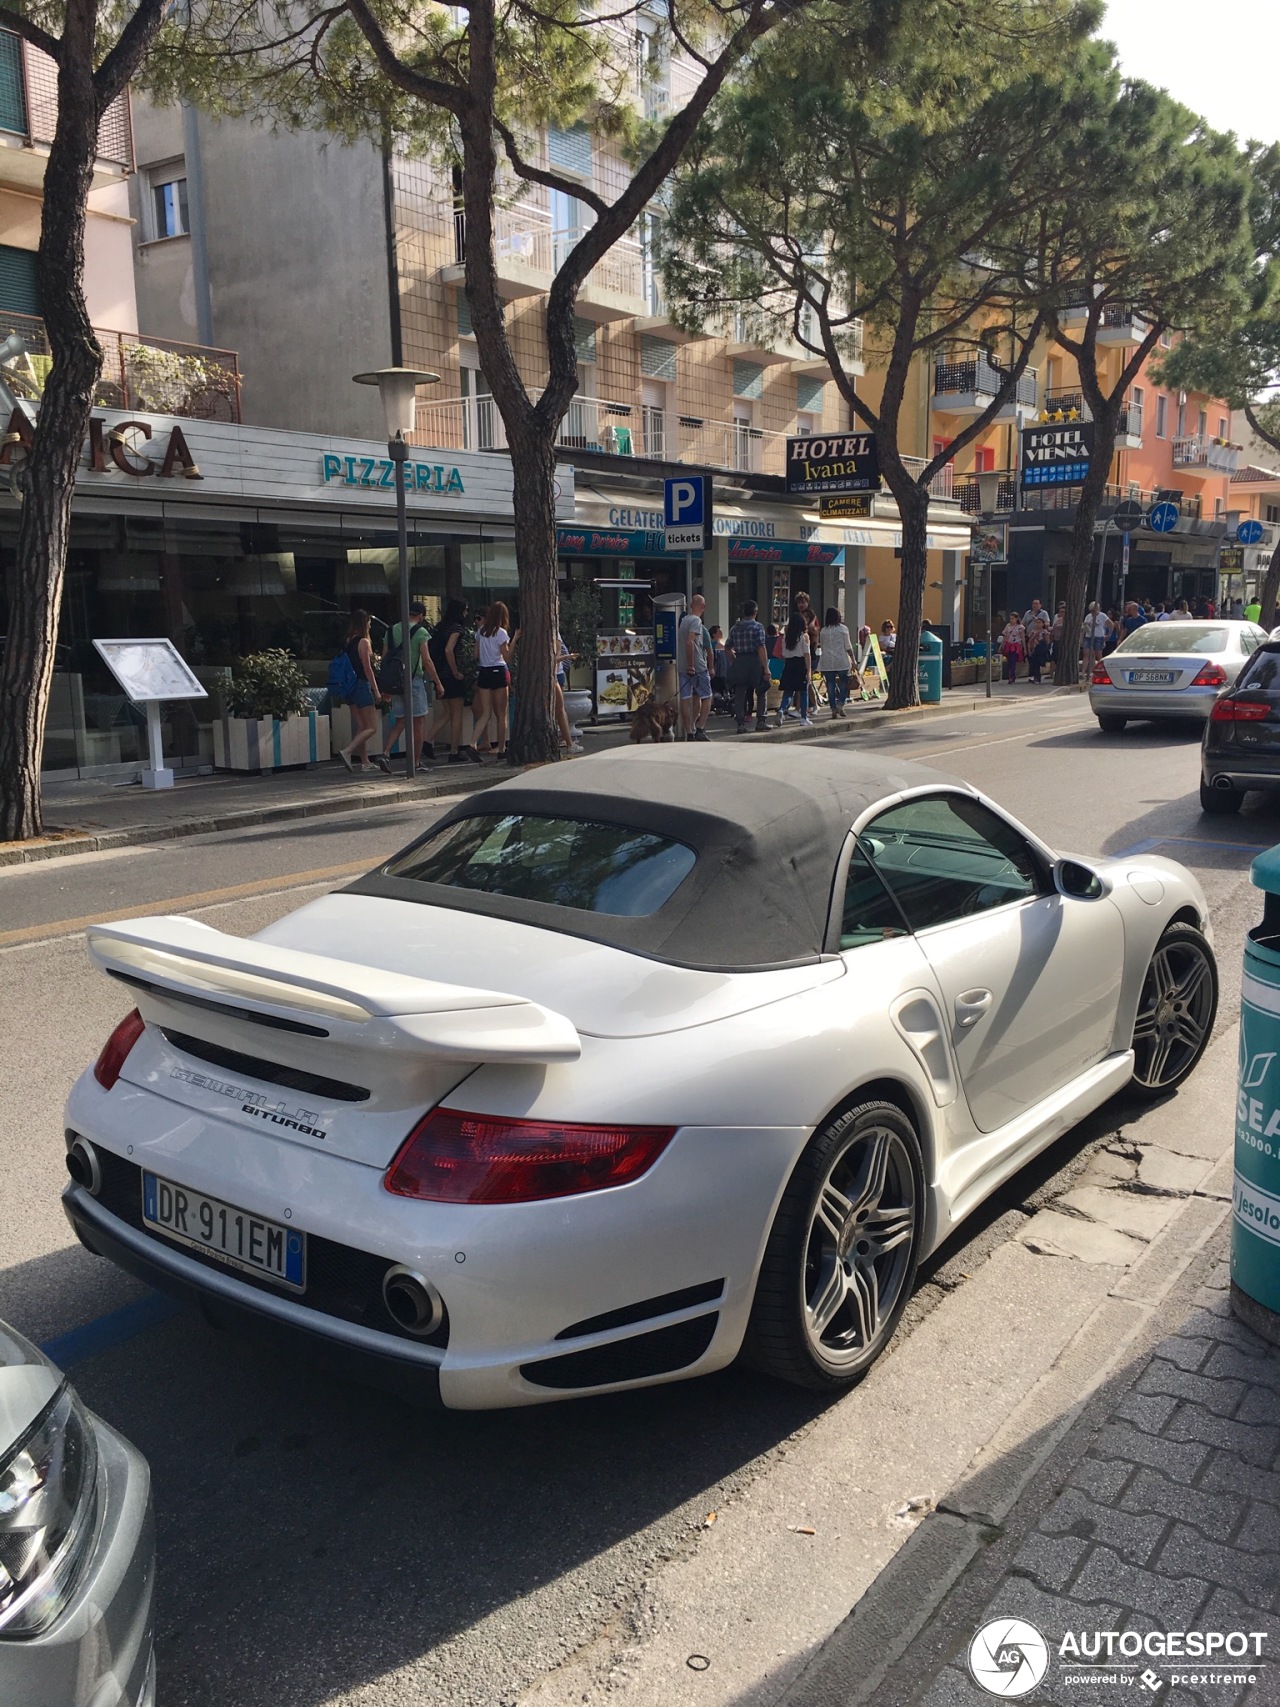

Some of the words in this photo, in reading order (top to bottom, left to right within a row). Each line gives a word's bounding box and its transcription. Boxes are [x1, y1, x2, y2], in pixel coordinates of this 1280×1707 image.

[1031, 430, 1085, 447] HOTEL
[791, 437, 870, 460] HOTEL
[1026, 444, 1090, 461] VIENNA
[323, 454, 465, 493] PIZZERIA
[803, 460, 857, 481] Ivana
[672, 482, 695, 521] P
[828, 497, 862, 509] CAMERE
[822, 507, 868, 517] CLIMATIZZATE
[590, 533, 630, 550] Drinks
[668, 534, 700, 544] tickets
[800, 525, 820, 541] BAR
[806, 545, 835, 561] Bar
[1135, 673, 1144, 681] DP
[170, 1067, 320, 1126] GEMBALLA
[242, 1104, 327, 1140] BITURBO
[1238, 1190, 1280, 1230] Jesolo
[159, 1183, 188, 1232] DR
[200, 1201, 284, 1273] 911EM
